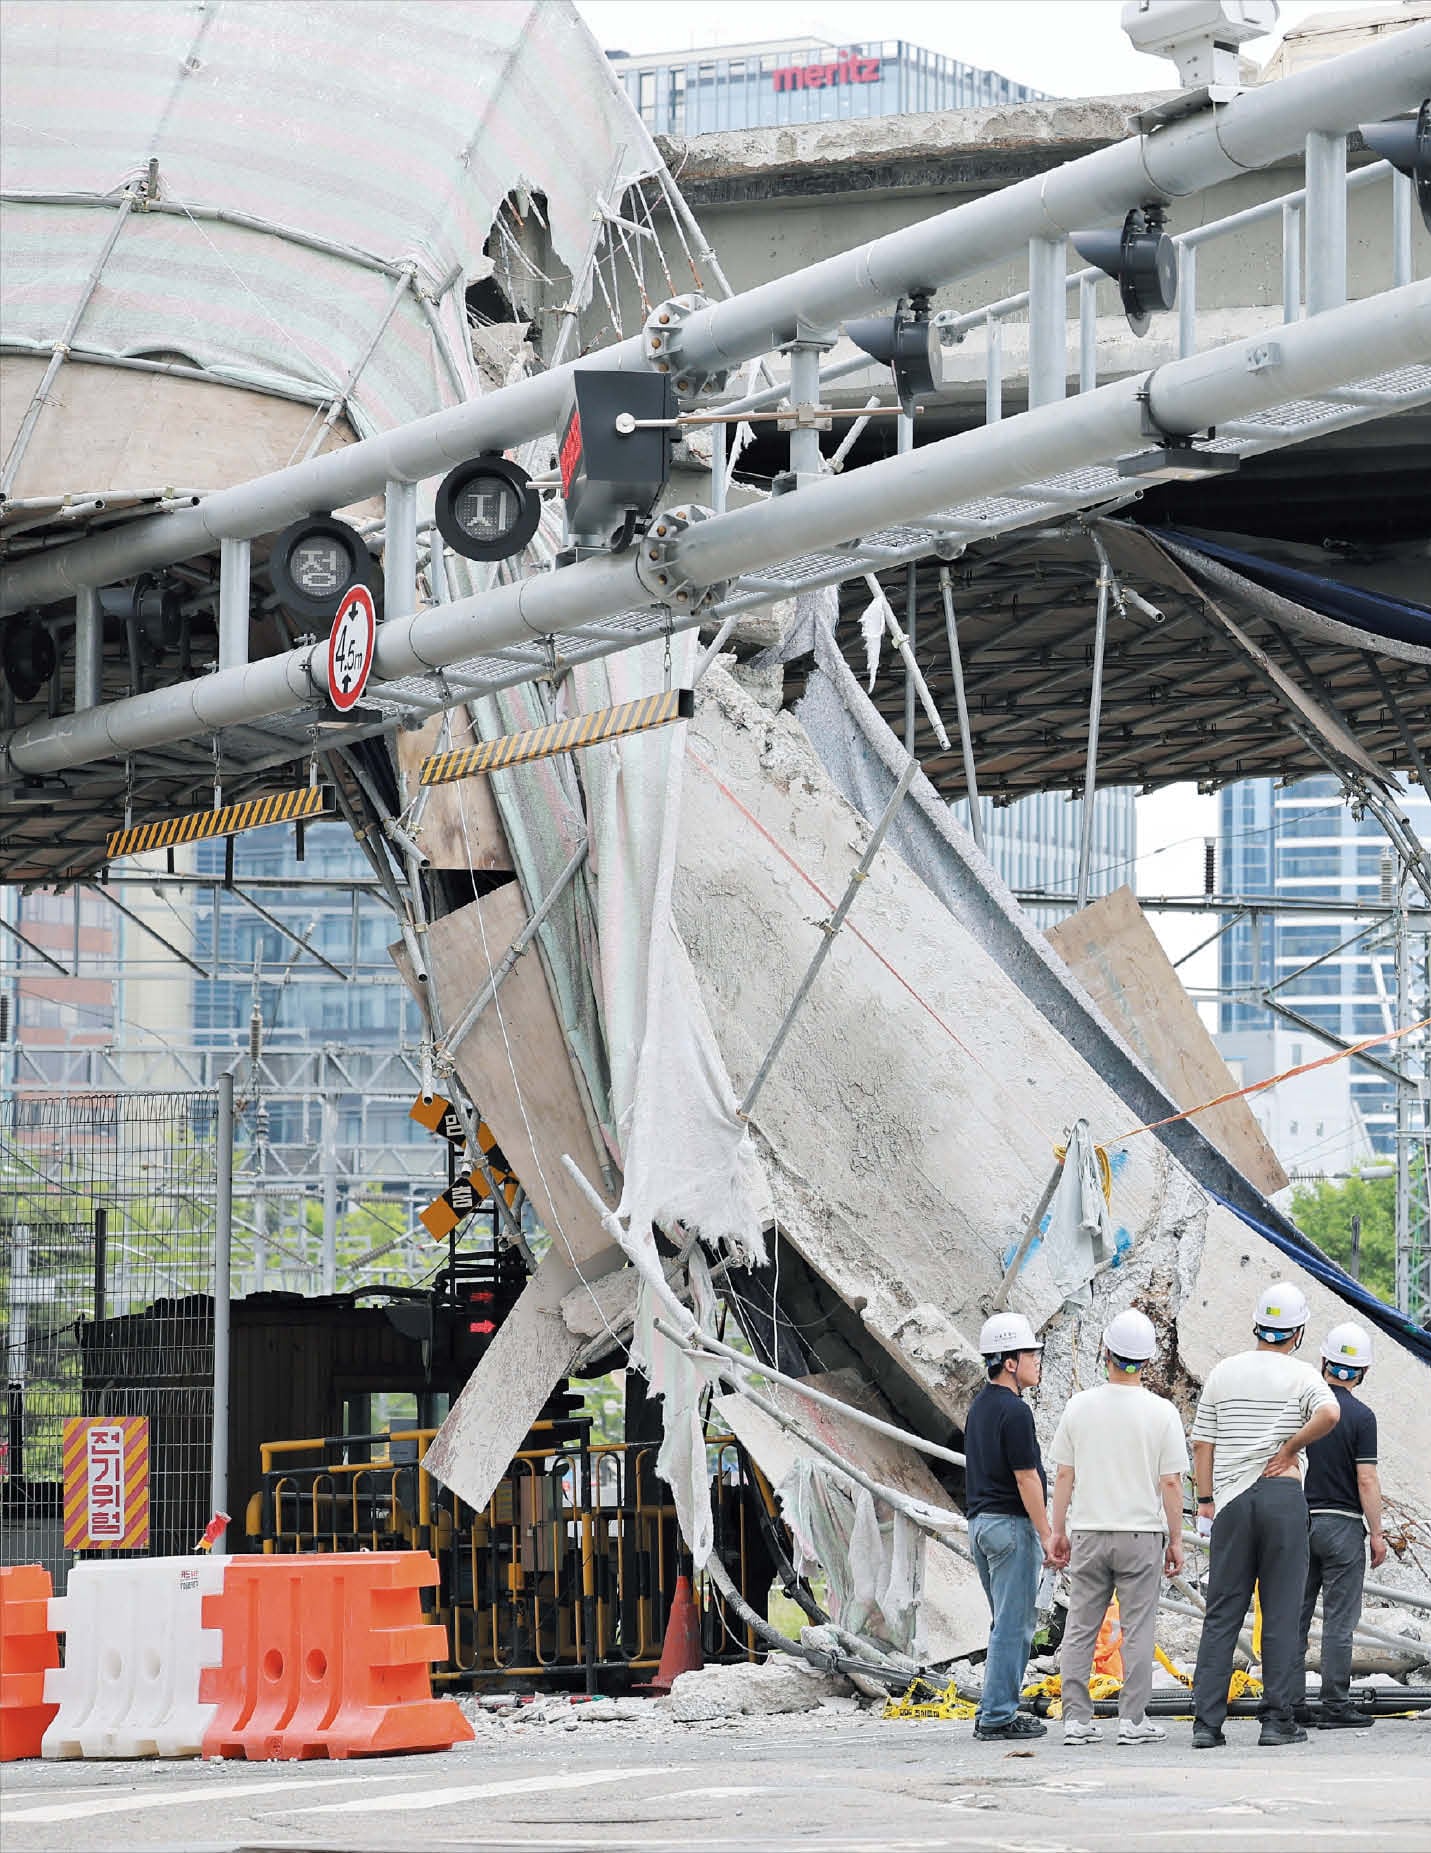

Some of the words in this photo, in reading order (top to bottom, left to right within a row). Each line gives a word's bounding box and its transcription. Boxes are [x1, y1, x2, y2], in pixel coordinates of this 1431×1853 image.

[773, 50, 880, 92] meritz
[467, 491, 507, 531] 지
[300, 550, 337, 587] 정
[336, 625, 362, 672] 4.5m
[91, 1431, 120, 1535] 전기위험
